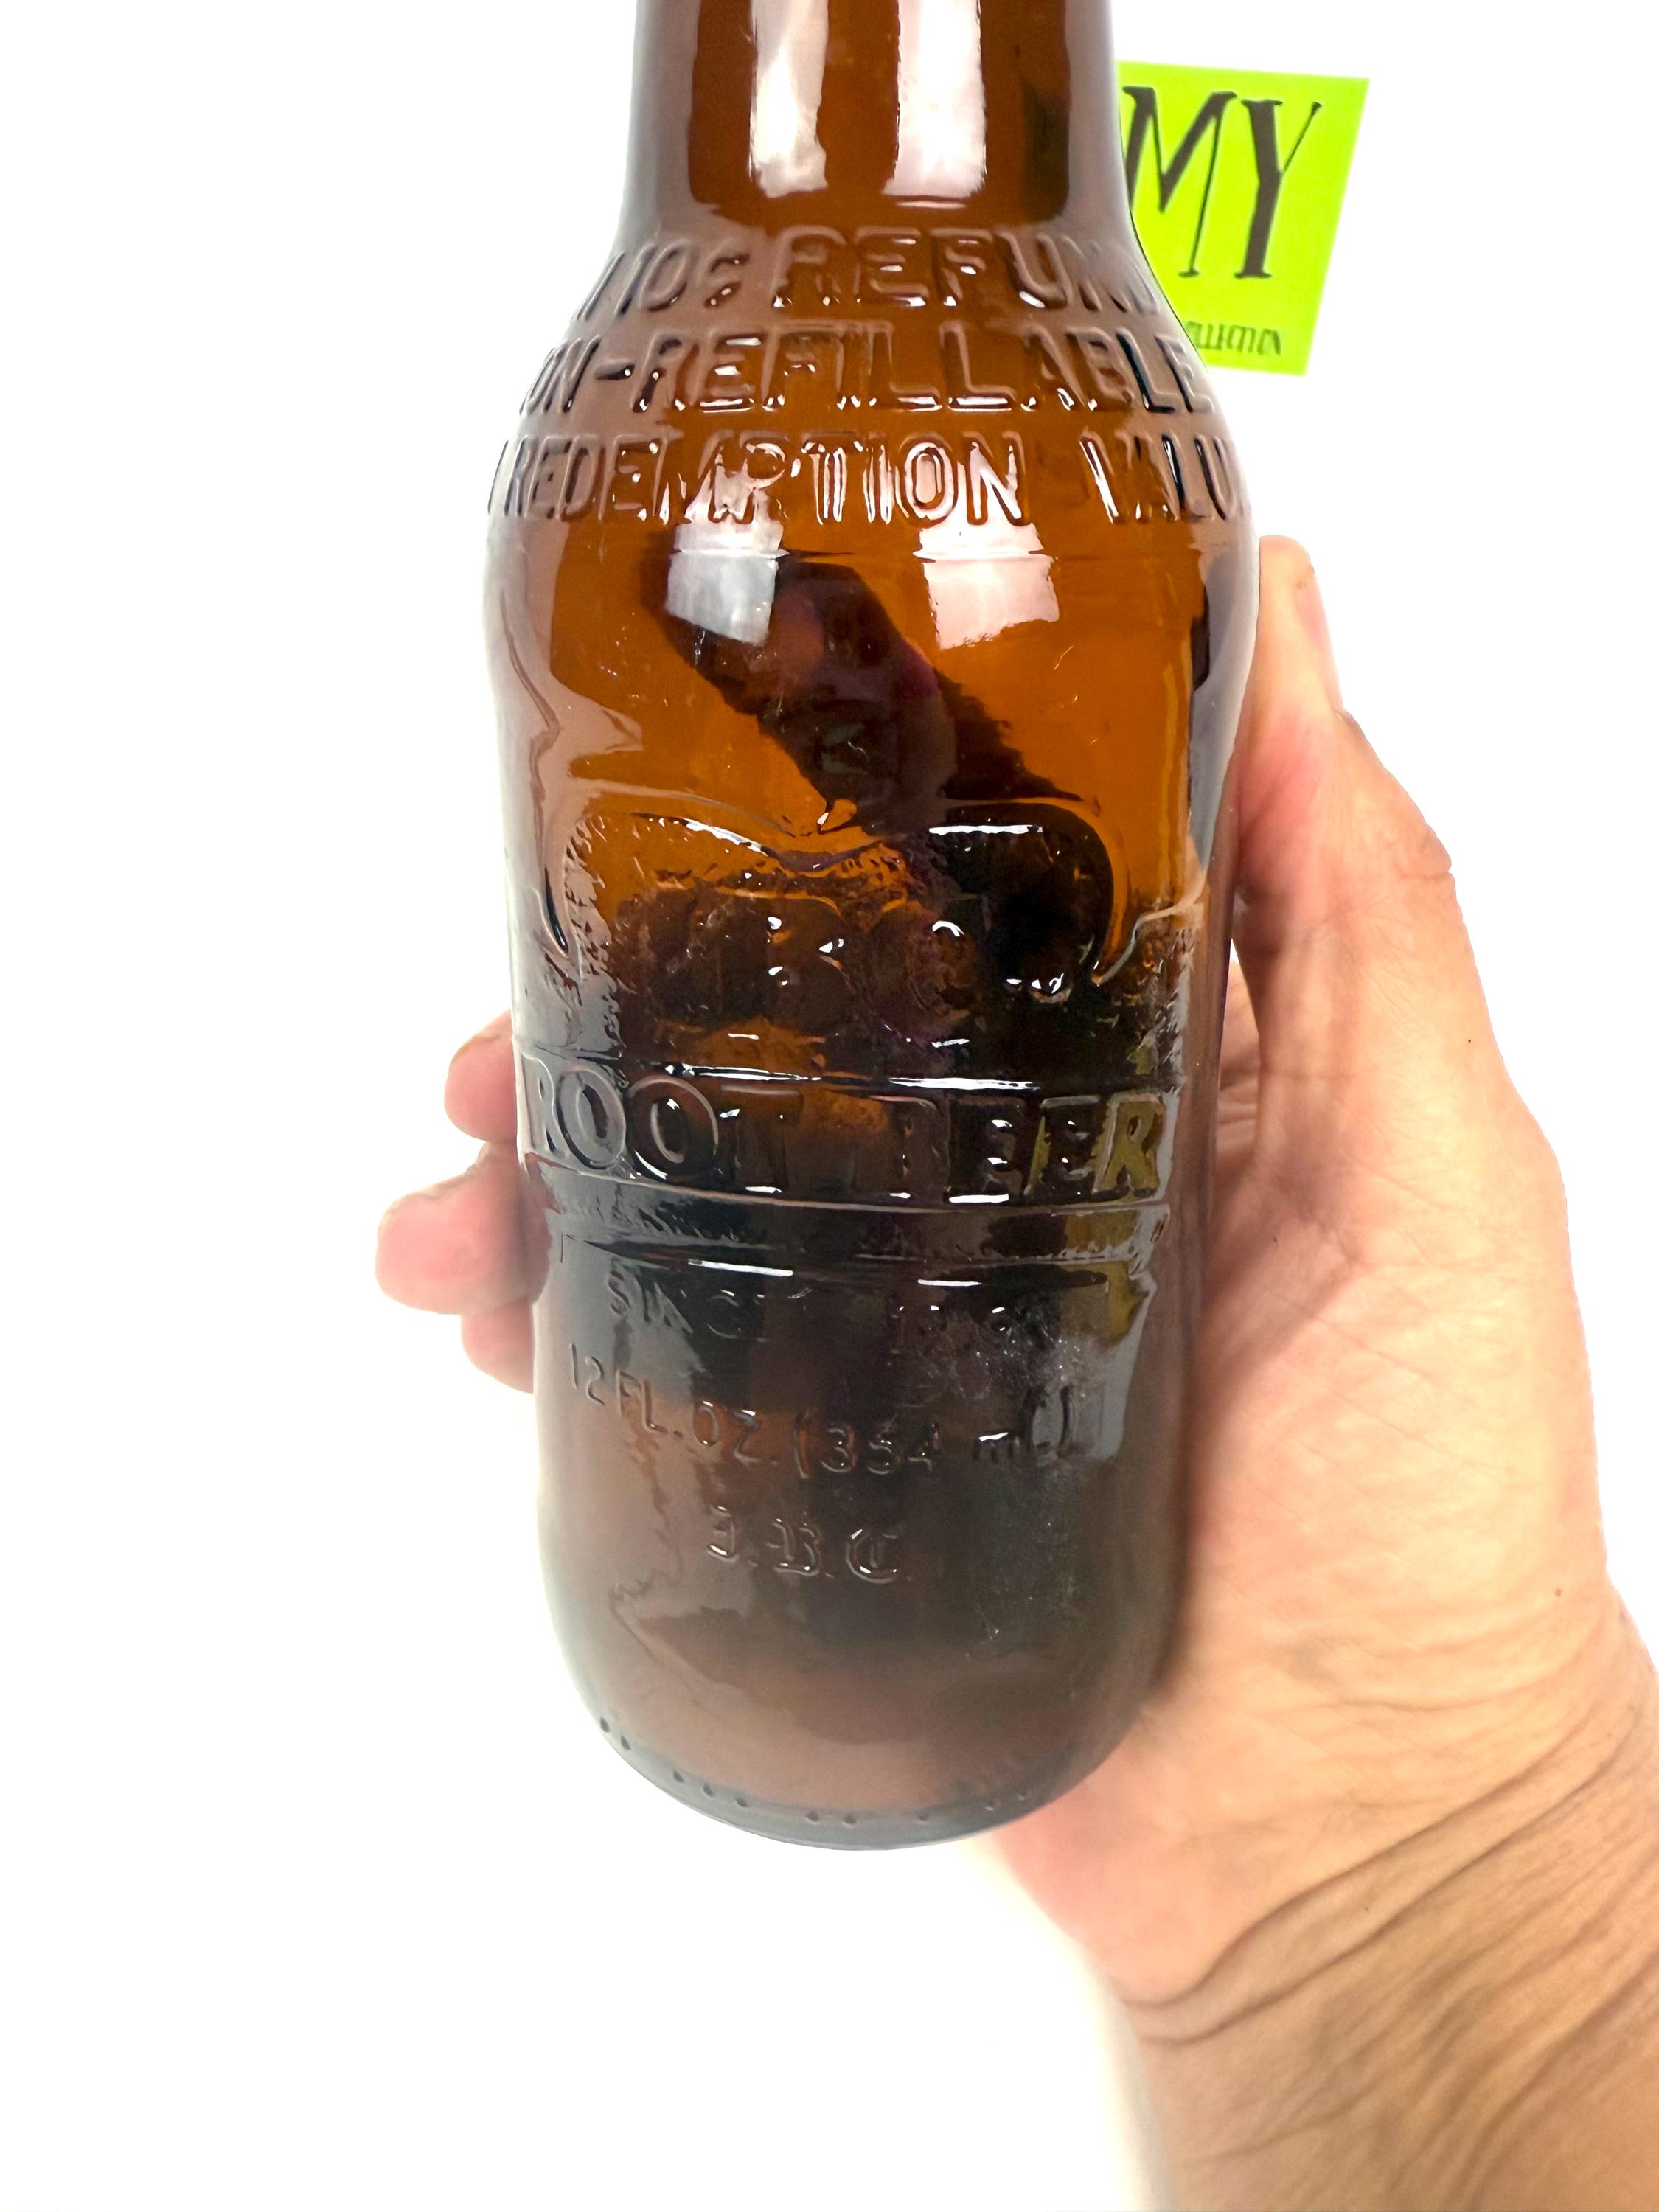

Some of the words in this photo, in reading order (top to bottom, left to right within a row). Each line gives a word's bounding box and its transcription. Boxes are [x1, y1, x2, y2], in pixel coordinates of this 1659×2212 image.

[1118, 84, 1324, 280] MY
[515, 1053, 801, 1196] ROOT
[869, 1090, 1166, 1205] BEER
